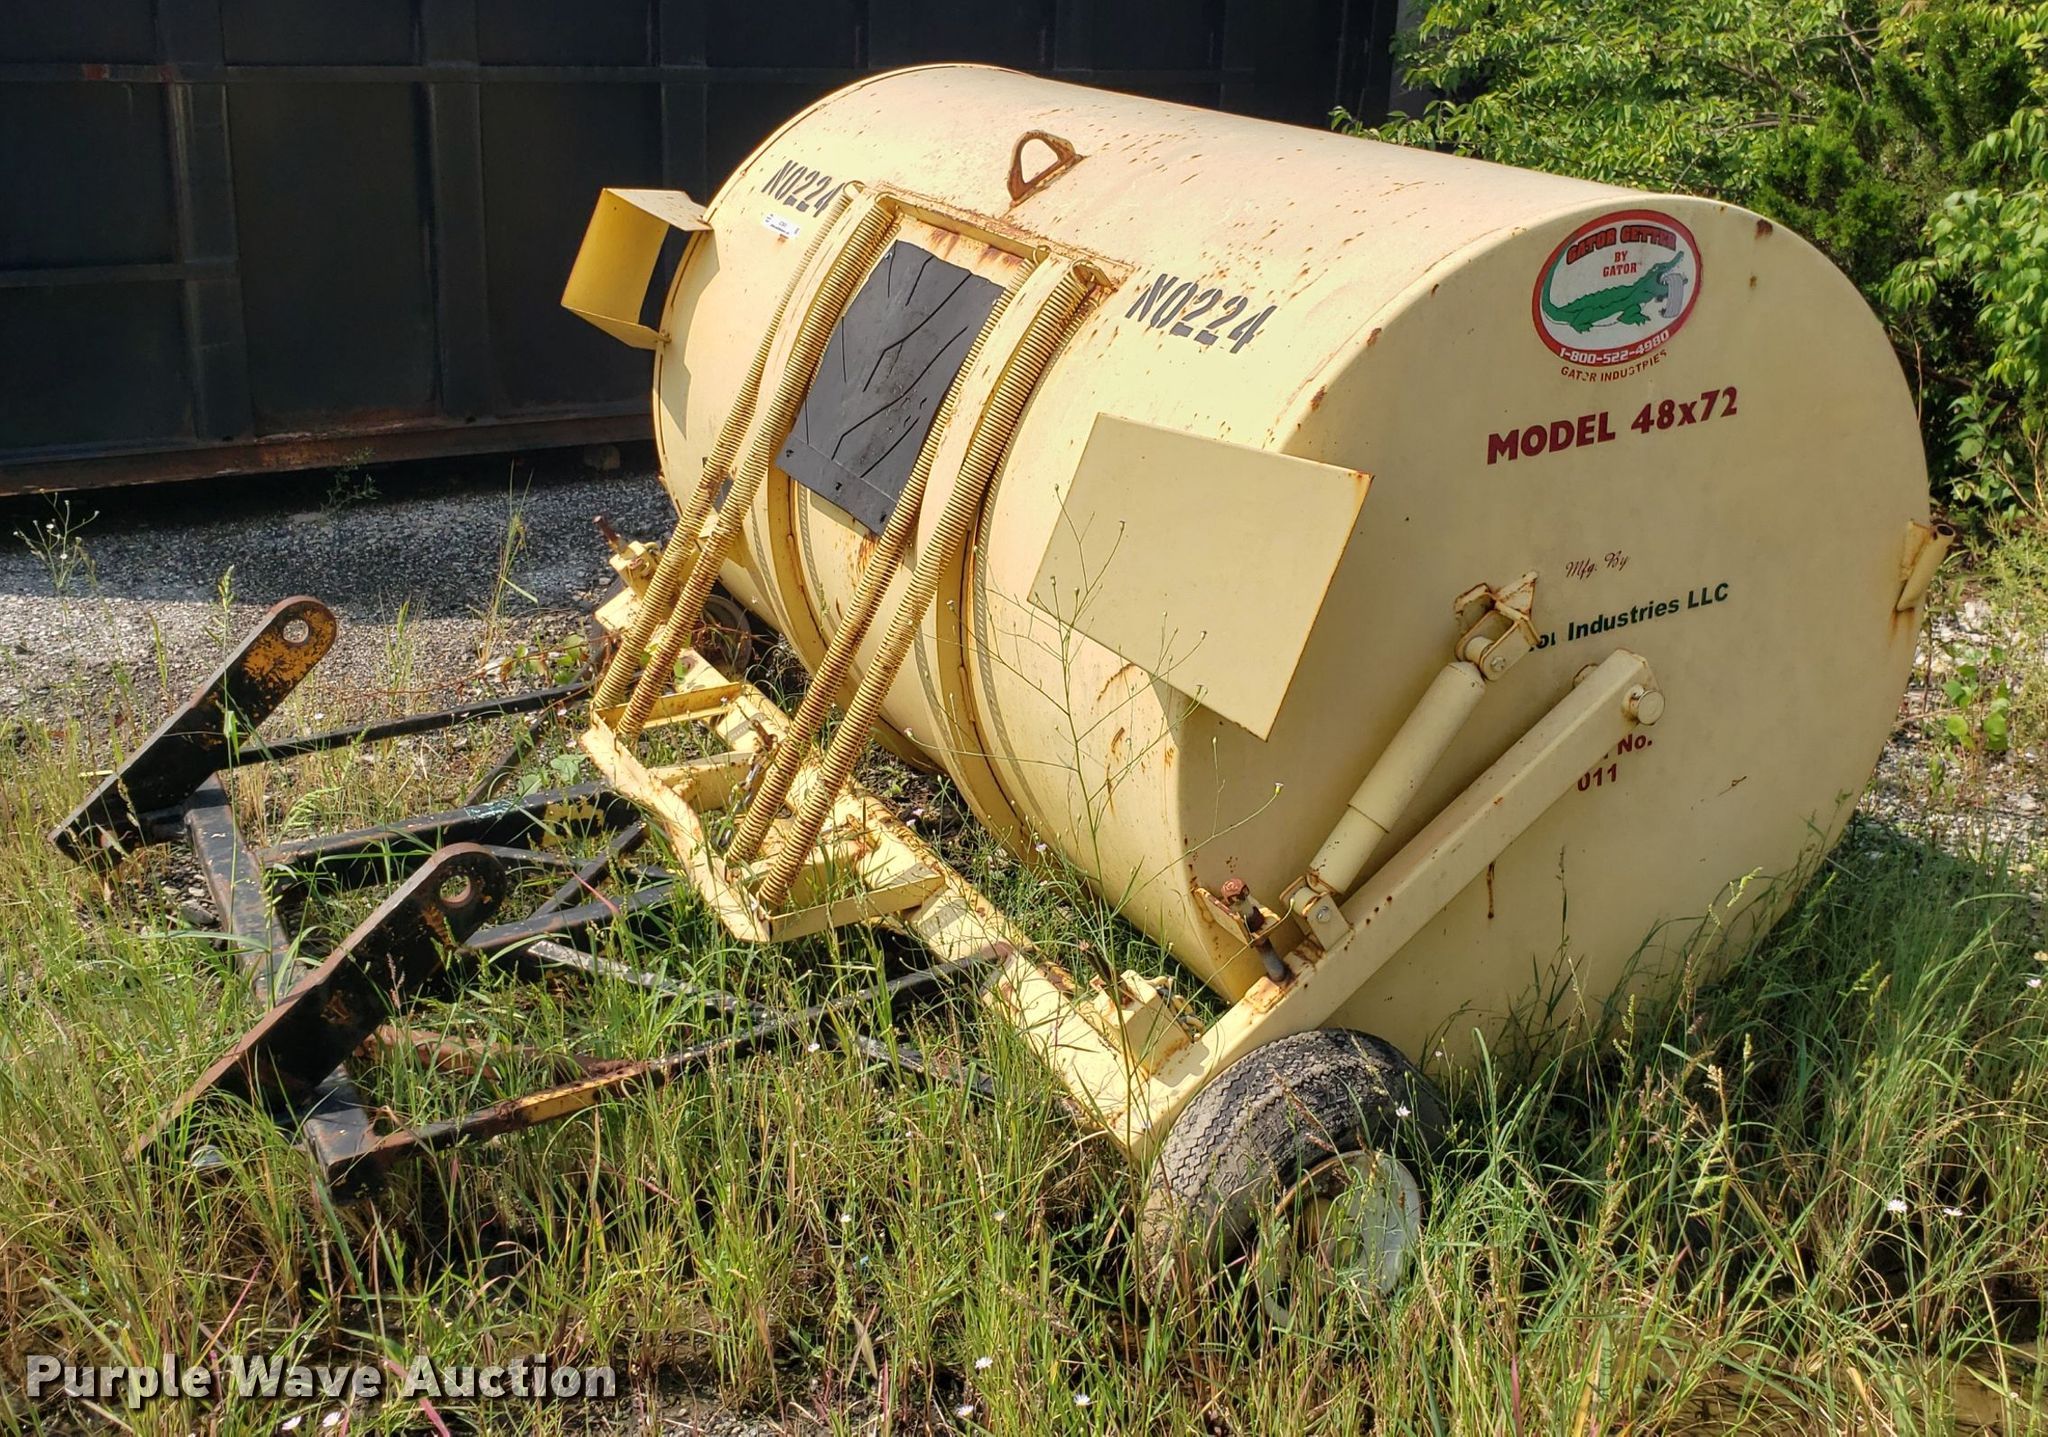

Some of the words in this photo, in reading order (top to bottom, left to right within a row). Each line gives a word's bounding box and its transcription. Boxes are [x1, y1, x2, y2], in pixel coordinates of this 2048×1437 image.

[1566, 227, 1617, 265] GATOR
[1614, 250, 1628, 263] BY
[1602, 262, 1637, 277] GATOR
[1559, 329, 1670, 364] 1-800-522-4980
[1561, 366, 1597, 382] GATOR
[1487, 411, 1617, 465] MODEL
[1630, 386, 1738, 434] 48x72
[1565, 558, 1598, 581] Mfg.
[1604, 550, 1631, 571] By
[1567, 600, 1680, 641] Industries
[1687, 582, 1729, 609] LLC
[1617, 733, 1653, 755] No.
